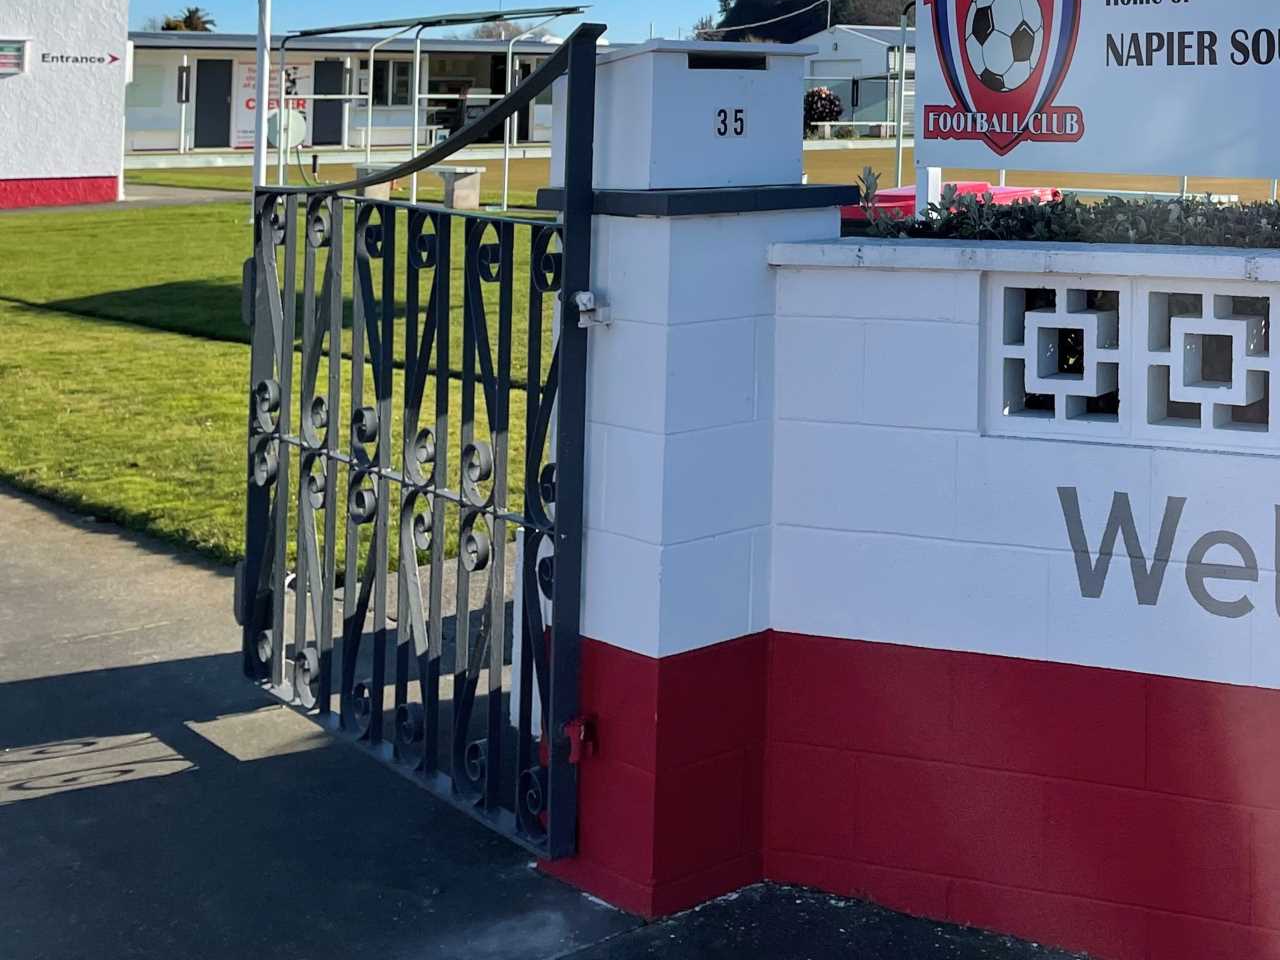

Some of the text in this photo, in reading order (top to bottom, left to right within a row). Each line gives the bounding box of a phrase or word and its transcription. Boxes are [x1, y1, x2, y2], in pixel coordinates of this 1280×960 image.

[41, 53, 105, 64] Entrance
[1106, 30, 1218, 67] NAPIER
[717, 109, 744, 136] 35
[928, 111, 1079, 135] FOOTBALL CLUB
